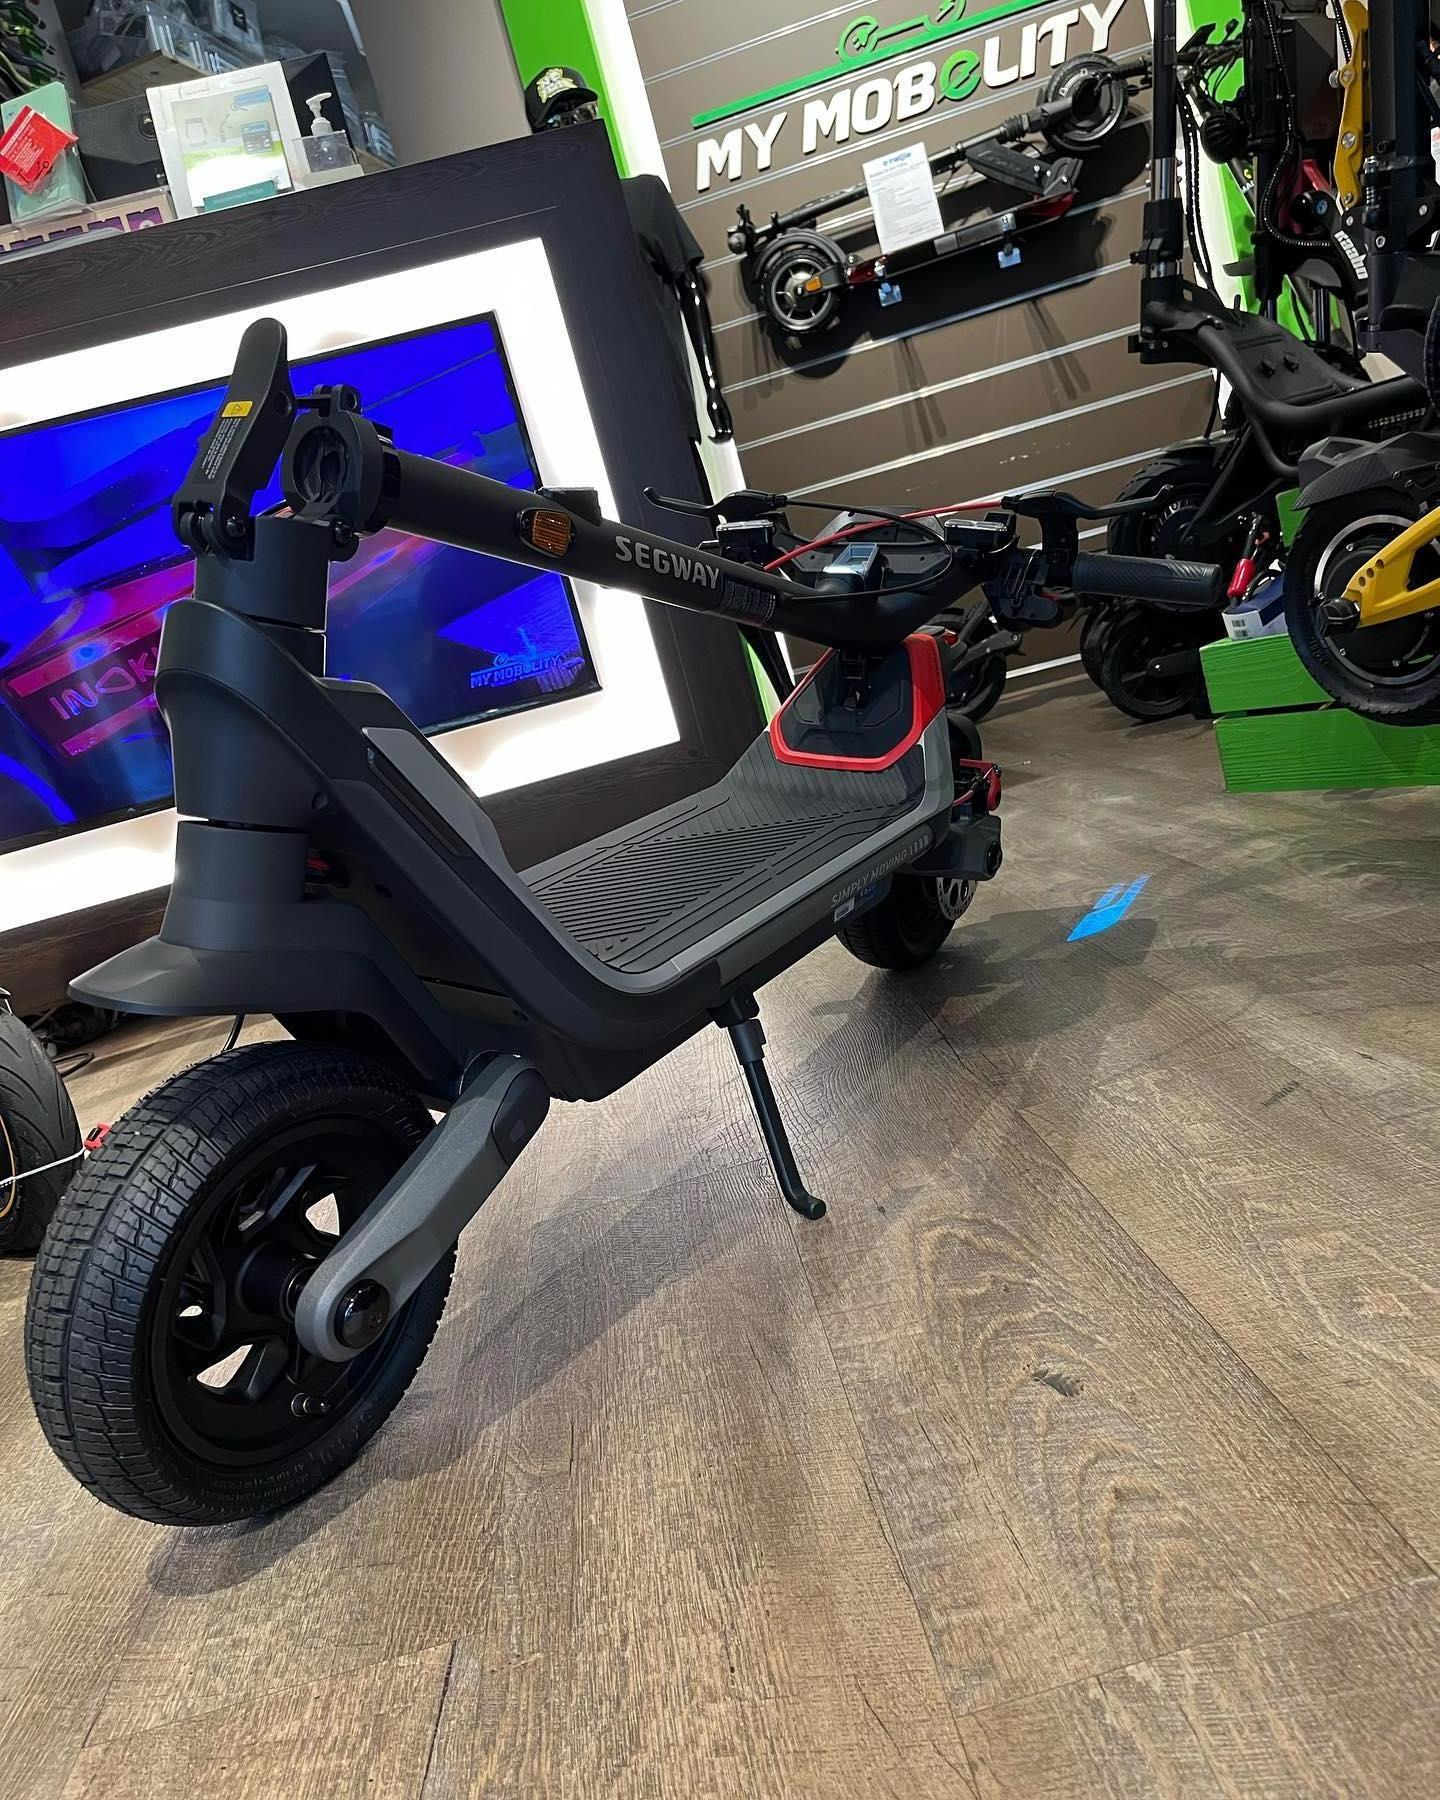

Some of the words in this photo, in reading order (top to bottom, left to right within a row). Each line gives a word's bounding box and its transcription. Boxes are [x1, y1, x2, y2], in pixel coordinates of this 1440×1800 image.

[696, 111, 788, 192] MY
[614, 535, 721, 590] SEGWAY
[50, 648, 157, 720] INOK
[470, 672, 493, 688] MY
[832, 875, 872, 904] SIMPLY
[870, 851, 908, 880] MOVING
